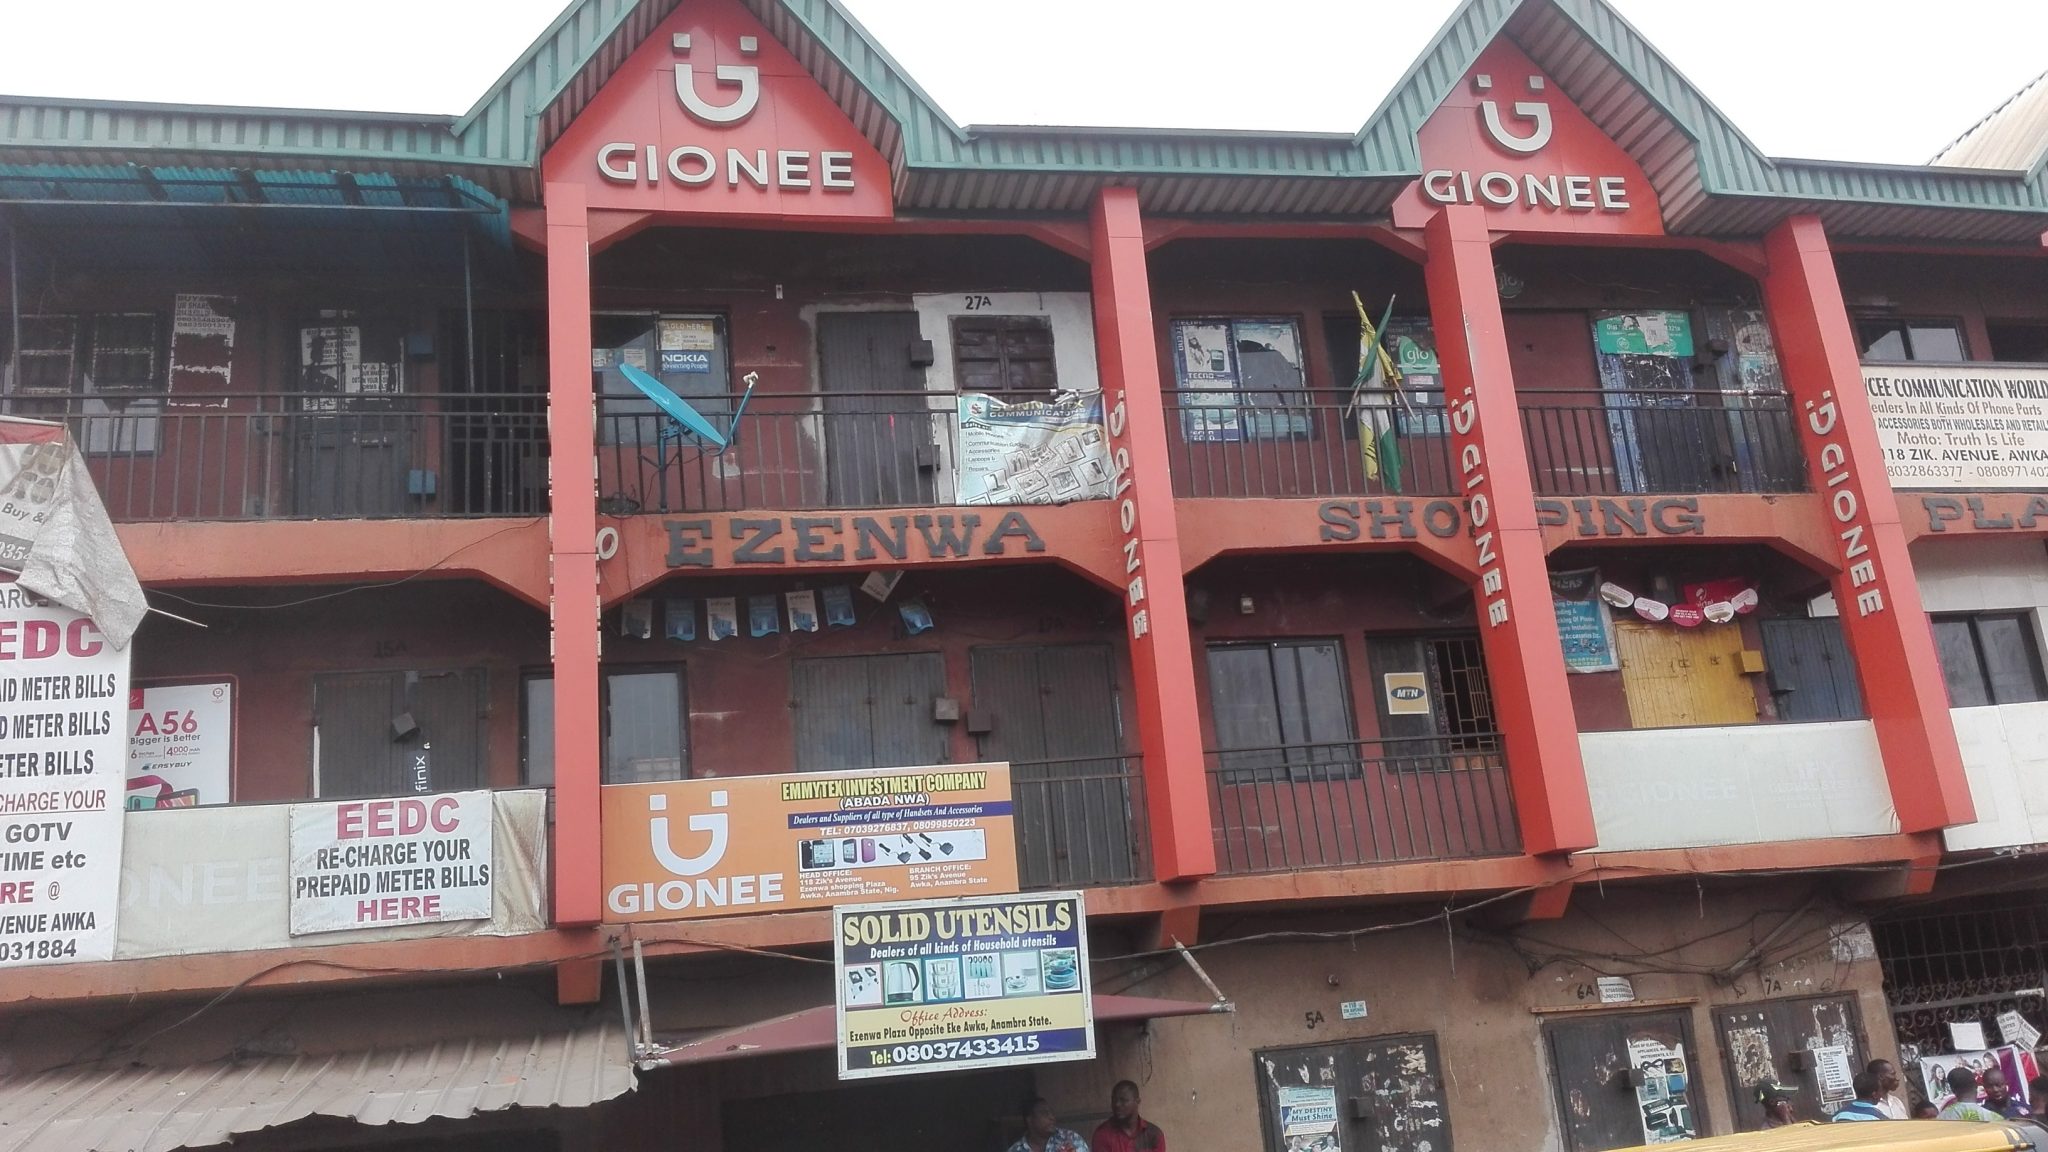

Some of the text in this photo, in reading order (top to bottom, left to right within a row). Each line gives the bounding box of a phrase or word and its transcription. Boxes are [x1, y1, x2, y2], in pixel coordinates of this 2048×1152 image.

[597, 142, 856, 191] GIONEE
[1423, 170, 1630, 211] GIONEE
[964, 295, 992, 311] 27A
[661, 353, 708, 362] NOKIA
[1407, 347, 1429, 364] glo
[1894, 378, 2003, 399] COMMUNICATION
[1906, 401, 1917, 414] In
[1919, 400, 1933, 414] All
[1936, 401, 1965, 415] Kinds
[1967, 400, 1980, 415] Of
[1982, 401, 2014, 416] Phone
[2016, 403, 2042, 416] Parts
[1878, 417, 1931, 430] ACCESSORIES
[1931, 417, 1951, 430] BOTH
[1953, 418, 2005, 431] WHOLESALES
[2006, 418, 2021, 431] AND
[1897, 431, 2025, 446] Motto: Truth Is Life
[1, 502, 30, 521] Buy
[664, 511, 1046, 568] EZENWA
[1318, 498, 1704, 541] SHOPING
[1462, 443, 1509, 628] GIONEE
[1821, 443, 1884, 617] GIONEE
[21, 675, 71, 702] METER
[75, 673, 116, 699] BILLS
[1396, 688, 1419, 698] MTN
[13, 712, 64, 740] METER
[68, 710, 111, 737] BILLS
[134, 709, 198, 737] A56
[130, 733, 201, 746] Bigger is Better
[45, 749, 94, 776] BILLS
[781, 771, 987, 801] EMMYTEX INVESTMENT COMPANY
[63, 789, 106, 809] YOUR
[839, 792, 931, 810] (ABADA NWA)
[336, 796, 461, 841] EEDC
[793, 804, 983, 825] Dealers and Suppliers of all type of Handsets And Accessories
[5, 822, 73, 844] GOTV
[820, 826, 842, 836] TEL:
[913, 818, 976, 830] 08099850223
[51, 850, 87, 870] etc
[316, 838, 471, 871] RE-CHARGE YOUR
[799, 869, 853, 879] HEAD OFFICE:
[834, 875, 862, 884] Avenue
[909, 864, 972, 875] BRANCH OFFICE:
[939, 871, 966, 880] Avenue
[48, 881, 60, 900] @
[296, 864, 490, 899] PREPAID METER BILLS
[799, 880, 886, 893] Ezenwa shopping Plaza
[934, 878, 967, 887] Anambra
[968, 876, 988, 885] State
[607, 872, 784, 914] GIONEE
[825, 889, 859, 898] Anambra
[356, 895, 442, 922] HERE
[50, 911, 96, 932] AWKA
[843, 902, 1072, 947] SOLID UTENSILS
[870, 934, 1057, 959] Dealers of all kinds of Household utensils
[1576, 983, 1595, 1000] 6A
[1764, 977, 1782, 996] 7A
[900, 1006, 988, 1025] Office Address:
[1305, 1010, 1325, 1030] 5A
[849, 1015, 1052, 1042] Ezenwa Plaza Opposite Eke Awka, Anambra State.
[870, 1034, 1040, 1065] Tel: 08037433415
[1291, 1113, 1333, 1122] Must Shine
[1304, 1106, 1333, 1114] DESTINY
